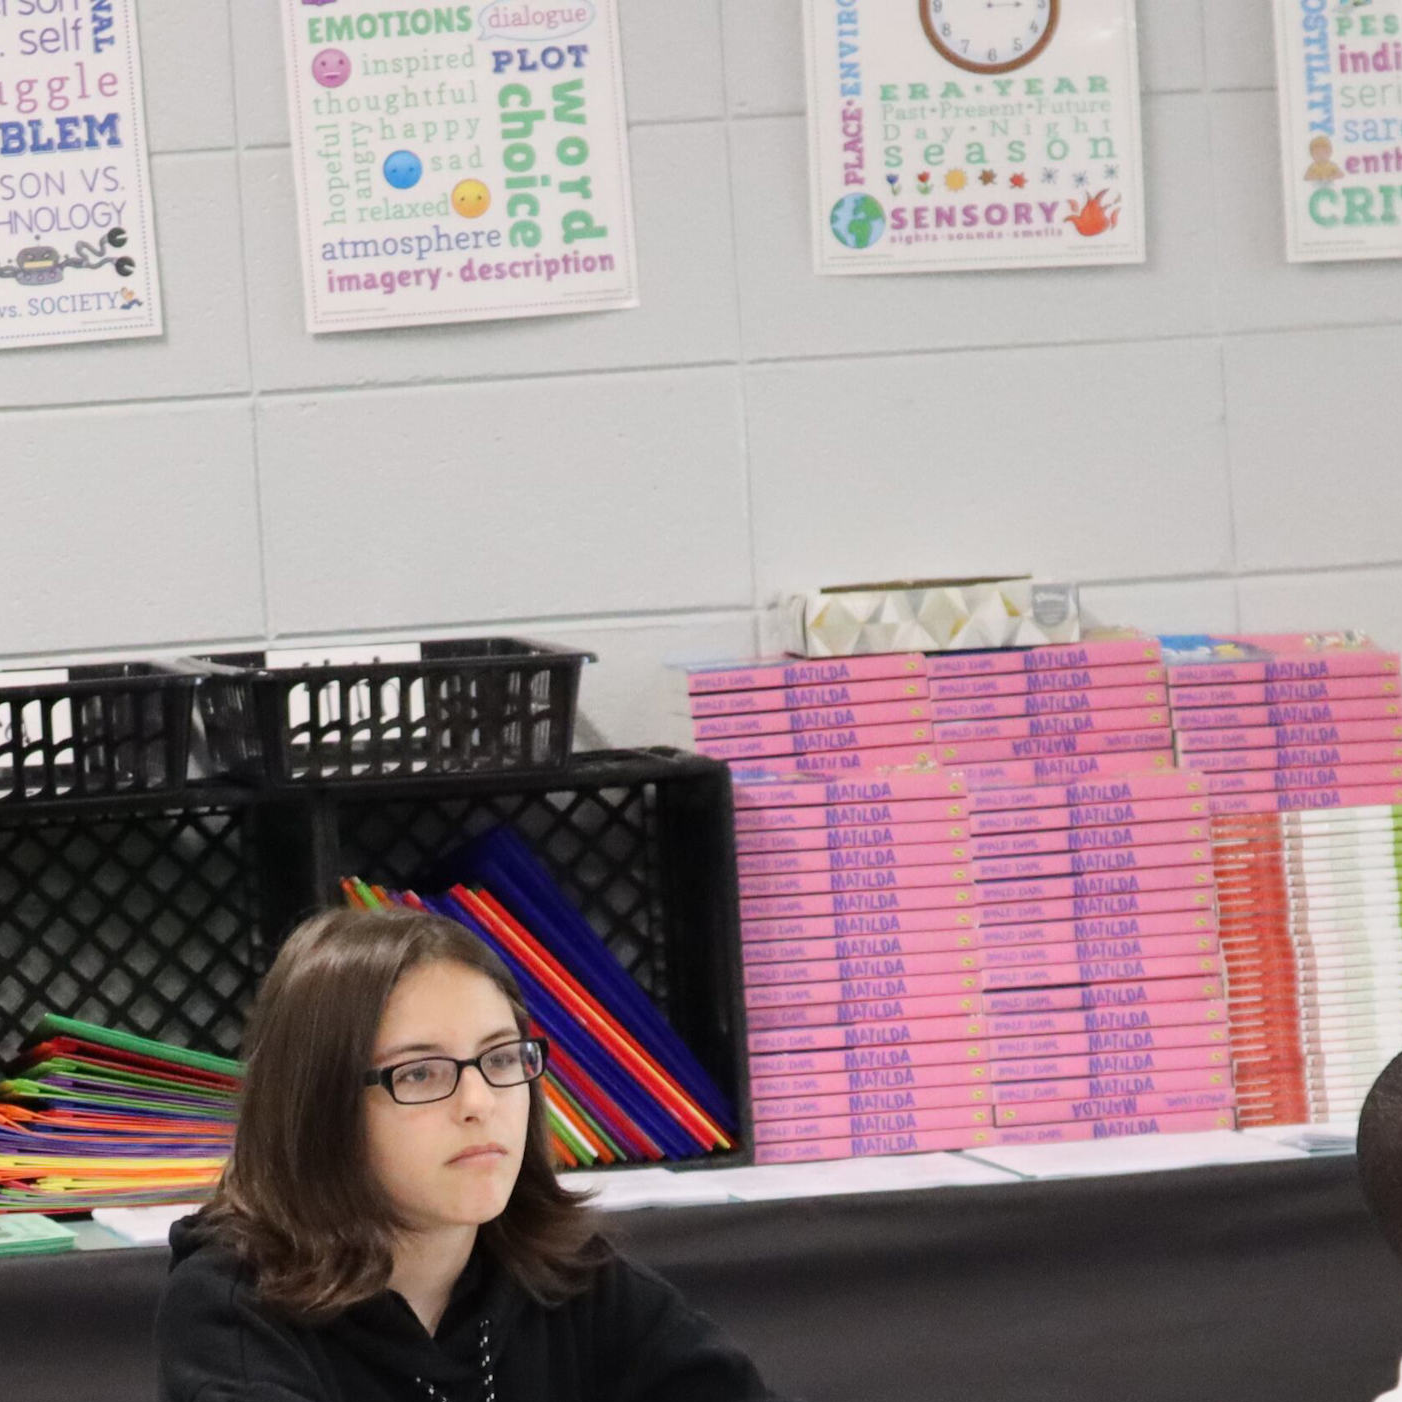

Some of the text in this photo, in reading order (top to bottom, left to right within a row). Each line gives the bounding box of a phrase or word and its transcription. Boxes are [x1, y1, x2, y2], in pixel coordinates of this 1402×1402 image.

[307, 6, 473, 44] EMOTIONS
[488, 3, 587, 31] dialogue
[19, 18, 84, 56] self
[361, 45, 475, 80] inspired
[491, 45, 589, 73] PLOT
[880, 76, 1109, 101] ERA YEAR
[313, 81, 477, 121] thoughtful
[882, 98, 1110, 121] Past Present Future
[379, 116, 481, 143] happy
[883, 118, 1110, 142] Day Night
[841, 108, 865, 187] PLACE
[884, 135, 1116, 167] season
[351, 121, 375, 199] angry
[430, 147, 484, 172] sad
[498, 83, 550, 248] choice
[551, 78, 608, 245] word
[79, 166, 125, 194] VS.
[315, 122, 346, 226] hopeful
[356, 194, 450, 222] relaxed
[890, 202, 1059, 230] SENSORY
[321, 226, 501, 262] atmosphere
[327, 250, 615, 295] imagery description
[28, 291, 120, 316] SOCIETY
[1023, 649, 1088, 669] MATILDA
[784, 664, 850, 685] MATILDA
[1027, 671, 1092, 691] MATILDA
[1264, 661, 1329, 681] MATILDA
[785, 687, 851, 707] MATILDA
[1025, 693, 1090, 713] MATILDA
[1265, 682, 1328, 703] MATILDA
[790, 710, 855, 731] MATILDA
[1029, 715, 1094, 735] MATILDA
[1268, 704, 1332, 725] MATILDA
[793, 731, 858, 752] MATILDA
[1012, 736, 1077, 756] MATILDA
[1275, 727, 1339, 746] MATILDA
[1034, 757, 1099, 778] MATILDA
[1277, 748, 1341, 768] MATILDA
[1274, 768, 1338, 790] MATILDA
[826, 782, 891, 801] MATILDA
[1067, 783, 1132, 803] MATILDA
[1277, 791, 1341, 810] MATILDA
[828, 829, 893, 847] MATILDA
[1071, 851, 1136, 871] MATILDA
[833, 893, 899, 912] MATILDA
[1074, 919, 1139, 939] MATILDA
[840, 960, 905, 979] MATILDA
[1081, 985, 1147, 1005] MATILDA
[845, 1026, 911, 1046] MATILDA
[1088, 1054, 1154, 1074] MATILDA
[1093, 1119, 1159, 1138] MATILDA
[851, 1135, 917, 1155] MATILDA
